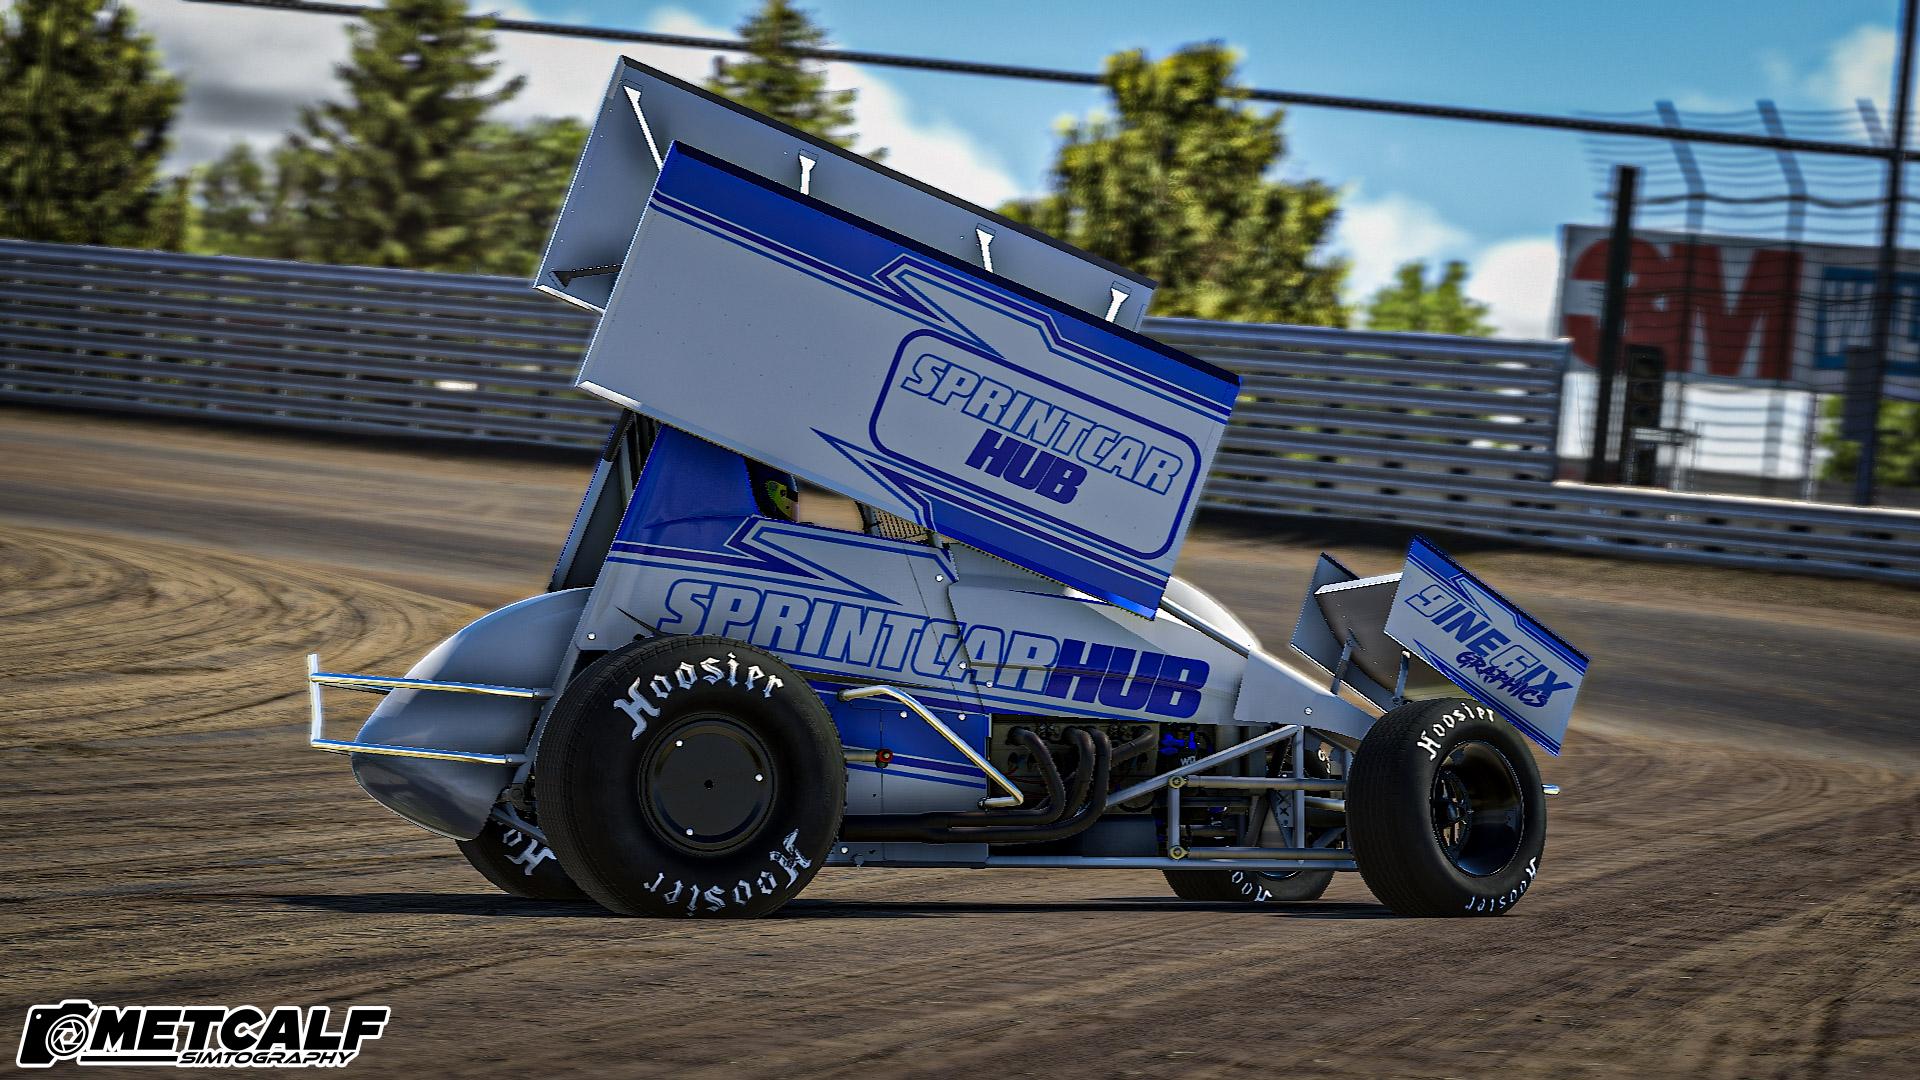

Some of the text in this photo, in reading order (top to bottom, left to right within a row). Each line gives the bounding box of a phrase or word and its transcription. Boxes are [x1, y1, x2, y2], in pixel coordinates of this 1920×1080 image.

[901, 353, 1182, 495] SPRINTCAR
[965, 429, 1088, 504] HUB
[613, 652, 784, 740] Hoosier
[1455, 650, 1548, 708] GRAPHICS
[1417, 702, 1495, 760] Hoosier
